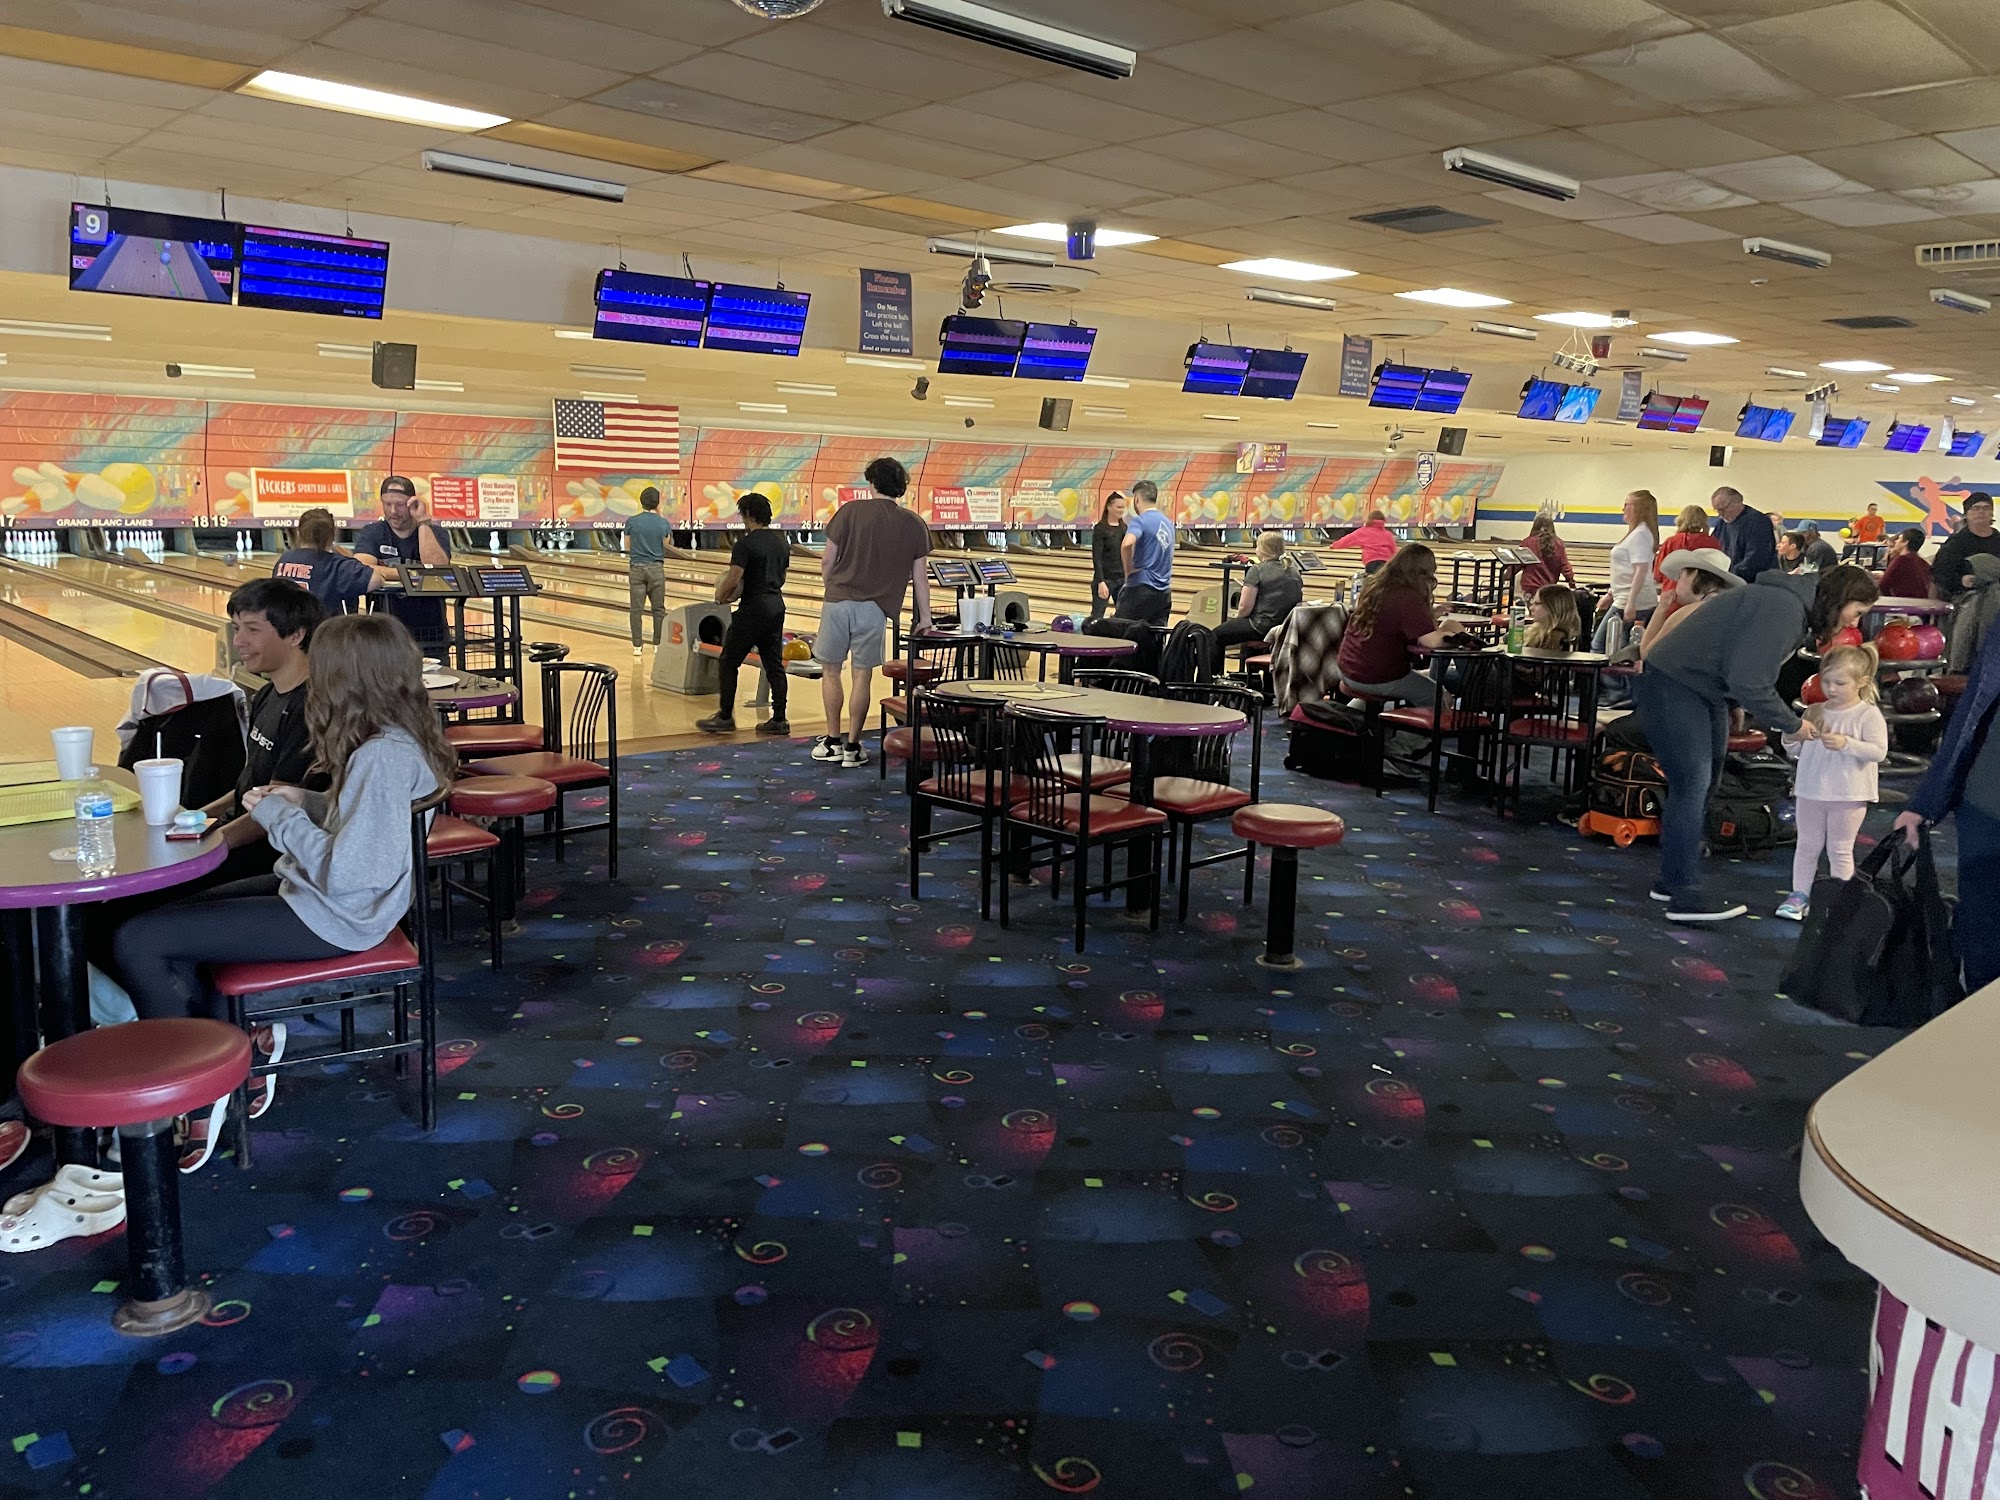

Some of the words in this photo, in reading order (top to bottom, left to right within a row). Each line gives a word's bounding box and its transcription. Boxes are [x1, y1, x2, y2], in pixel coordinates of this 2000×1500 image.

[86, 214, 101, 235] 9
[73, 257, 88, 267] DC
[874, 273, 899, 284] Please
[866, 282, 907, 295] Remember
[864, 310, 877, 318] Take
[877, 312, 898, 320] practice
[871, 320, 883, 328] Loft
[863, 332, 879, 340] Cross
[258, 478, 296, 495] KICKERS
[298, 484, 317, 493] SPORTS
[493, 483, 516, 491] Bowling
[934, 496, 965, 504] SOLUTION
[940, 511, 959, 519] TAXES
[56, 518, 90, 527] GRAND
[91, 518, 123, 527] BLANC
[124, 518, 154, 527] LANES
[192, 515, 209, 528] 18
[211, 515, 229, 528] 19
[263, 519, 293, 528] GRAND
[440, 520, 465, 528] GRAND
[540, 518, 552, 529] 22
[555, 518, 568, 529] 23
[679, 520, 691, 530] 24
[693, 520, 704, 530] 25
[801, 520, 812, 529] 26
[814, 520, 824, 529] 27
[1003, 521, 1013, 530] 30
[1014, 521, 1023, 530] 31
[671, 622, 684, 645] B
